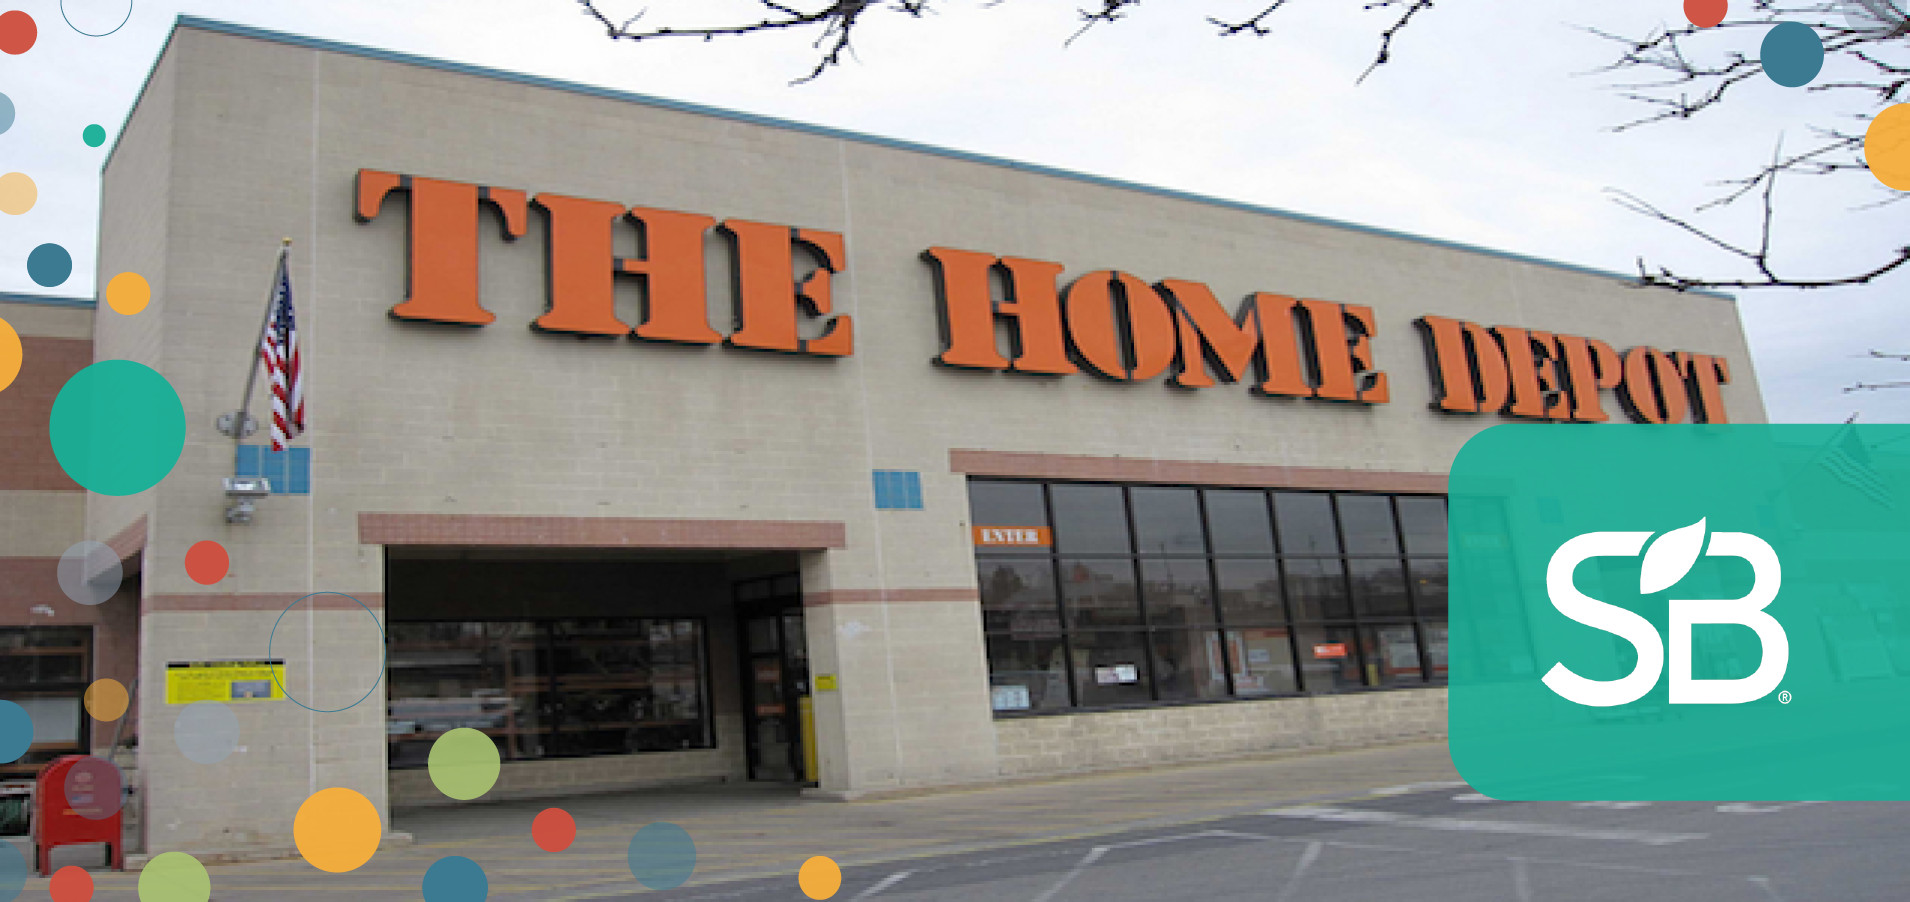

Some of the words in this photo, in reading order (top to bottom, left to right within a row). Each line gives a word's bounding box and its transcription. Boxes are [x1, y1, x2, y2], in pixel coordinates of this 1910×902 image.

[355, 168, 854, 357] THE
[921, 246, 1390, 404] HOME
[1414, 315, 1731, 424] DEPOT
